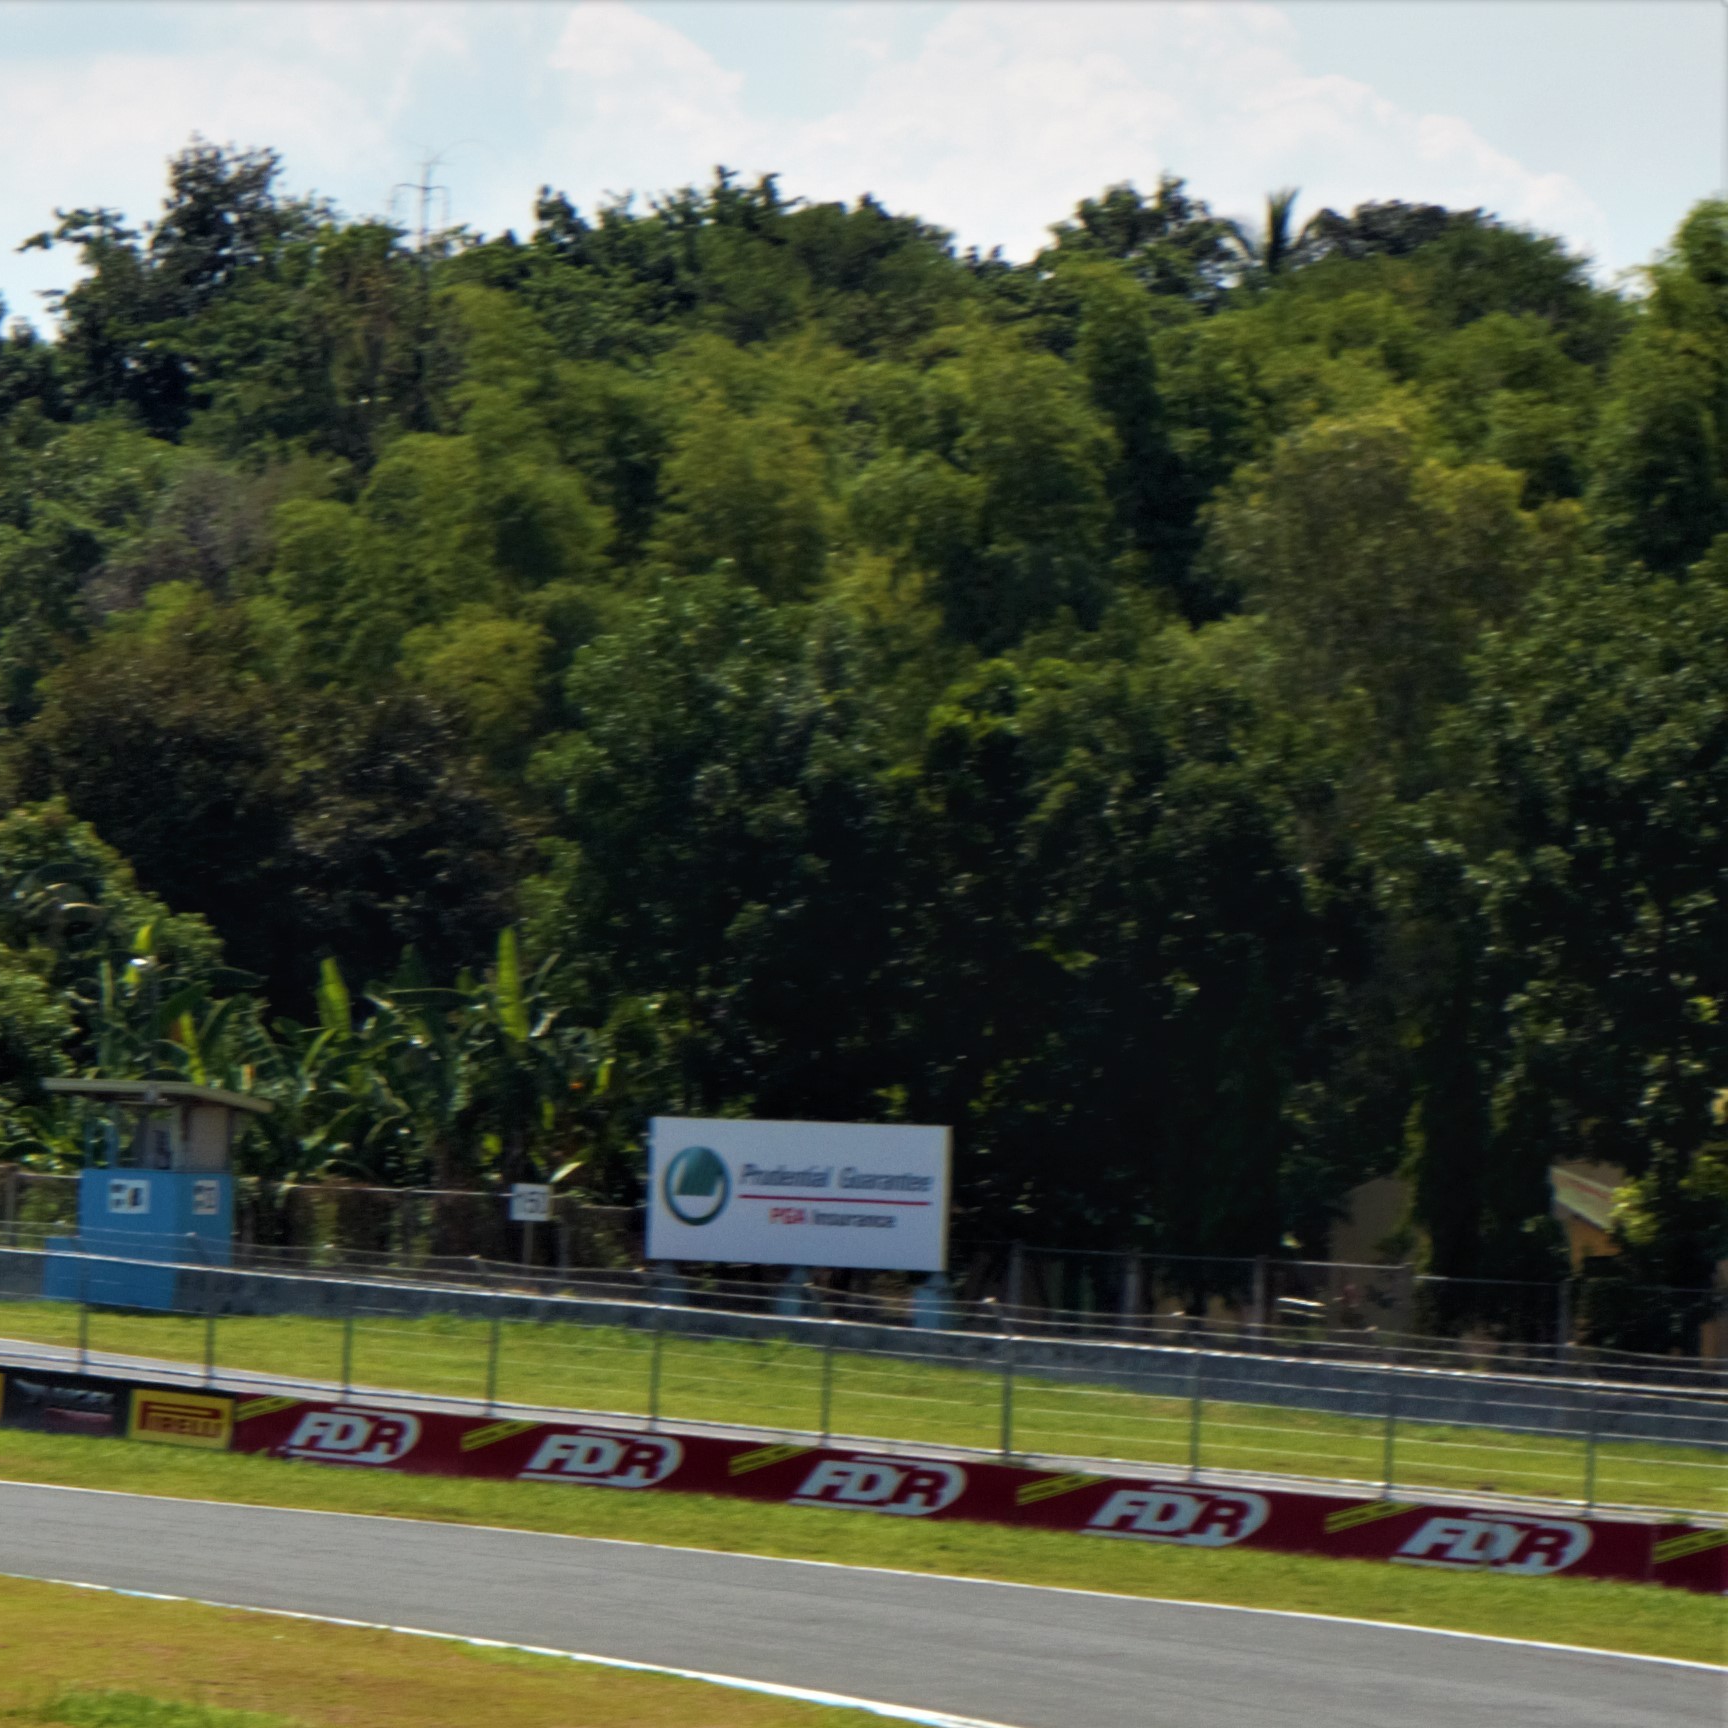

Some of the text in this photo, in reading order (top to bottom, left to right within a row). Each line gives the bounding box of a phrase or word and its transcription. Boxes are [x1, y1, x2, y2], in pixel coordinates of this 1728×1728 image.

[740, 1162, 933, 1192] Prudential Guarantee
[812, 1211, 896, 1229] Insurance
[279, 1406, 420, 1464] FDR
[518, 1428, 683, 1487] FDR
[789, 1454, 967, 1516] FDR
[1080, 1484, 1270, 1547] FDR
[1390, 1511, 1593, 1575] FDR
